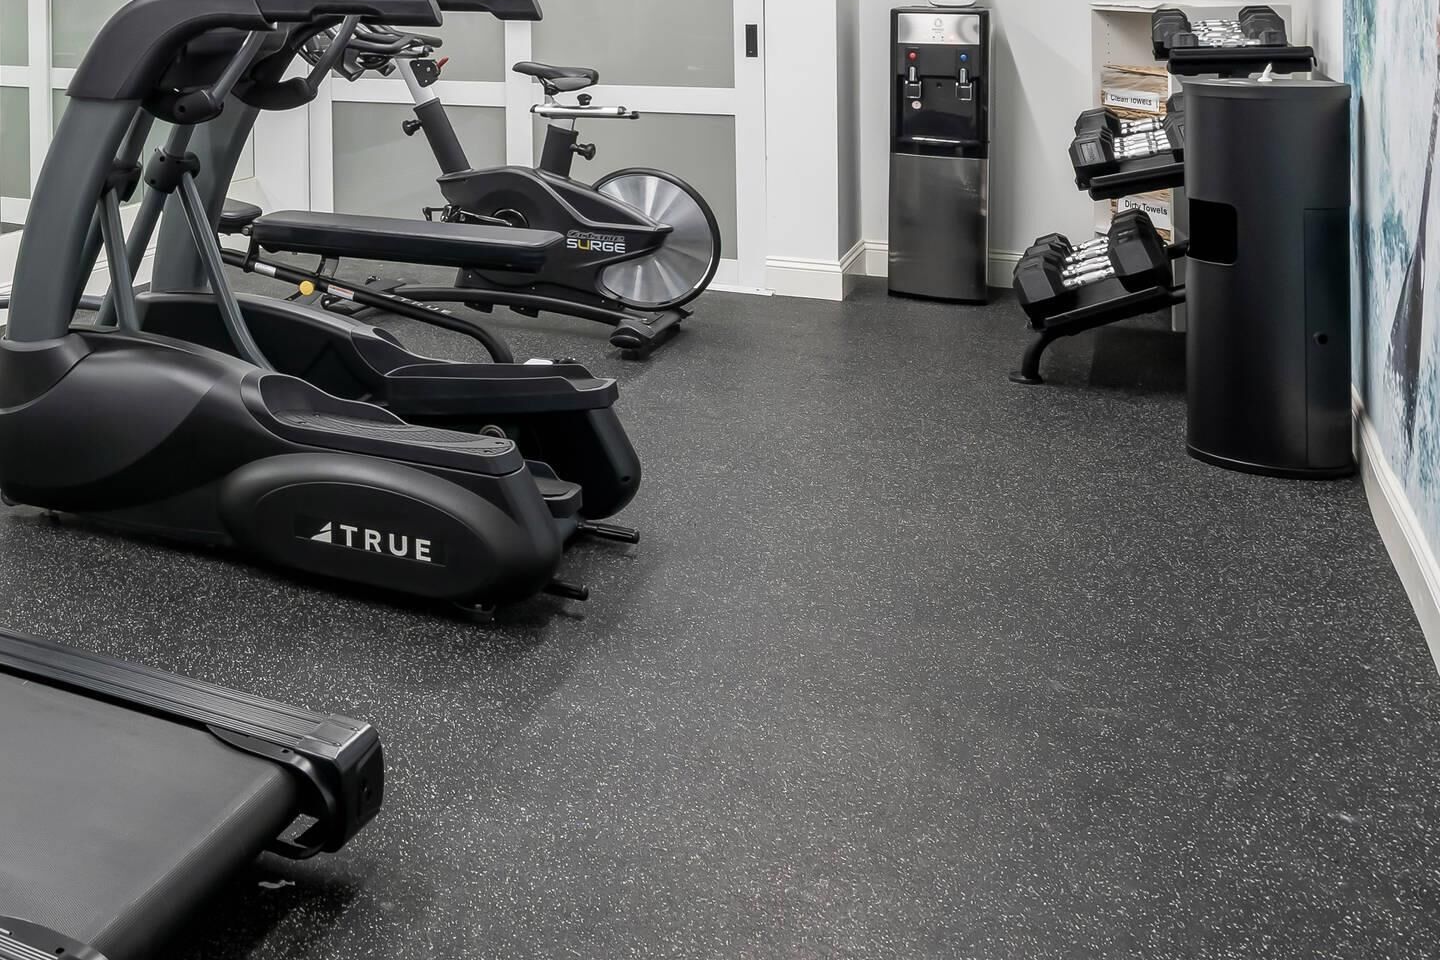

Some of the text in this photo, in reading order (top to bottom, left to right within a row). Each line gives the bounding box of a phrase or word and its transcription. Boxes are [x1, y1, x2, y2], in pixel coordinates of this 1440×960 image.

[1143, 203, 1168, 215] Towels
[566, 238, 626, 254] SURGE
[339, 524, 432, 562] TRUE
